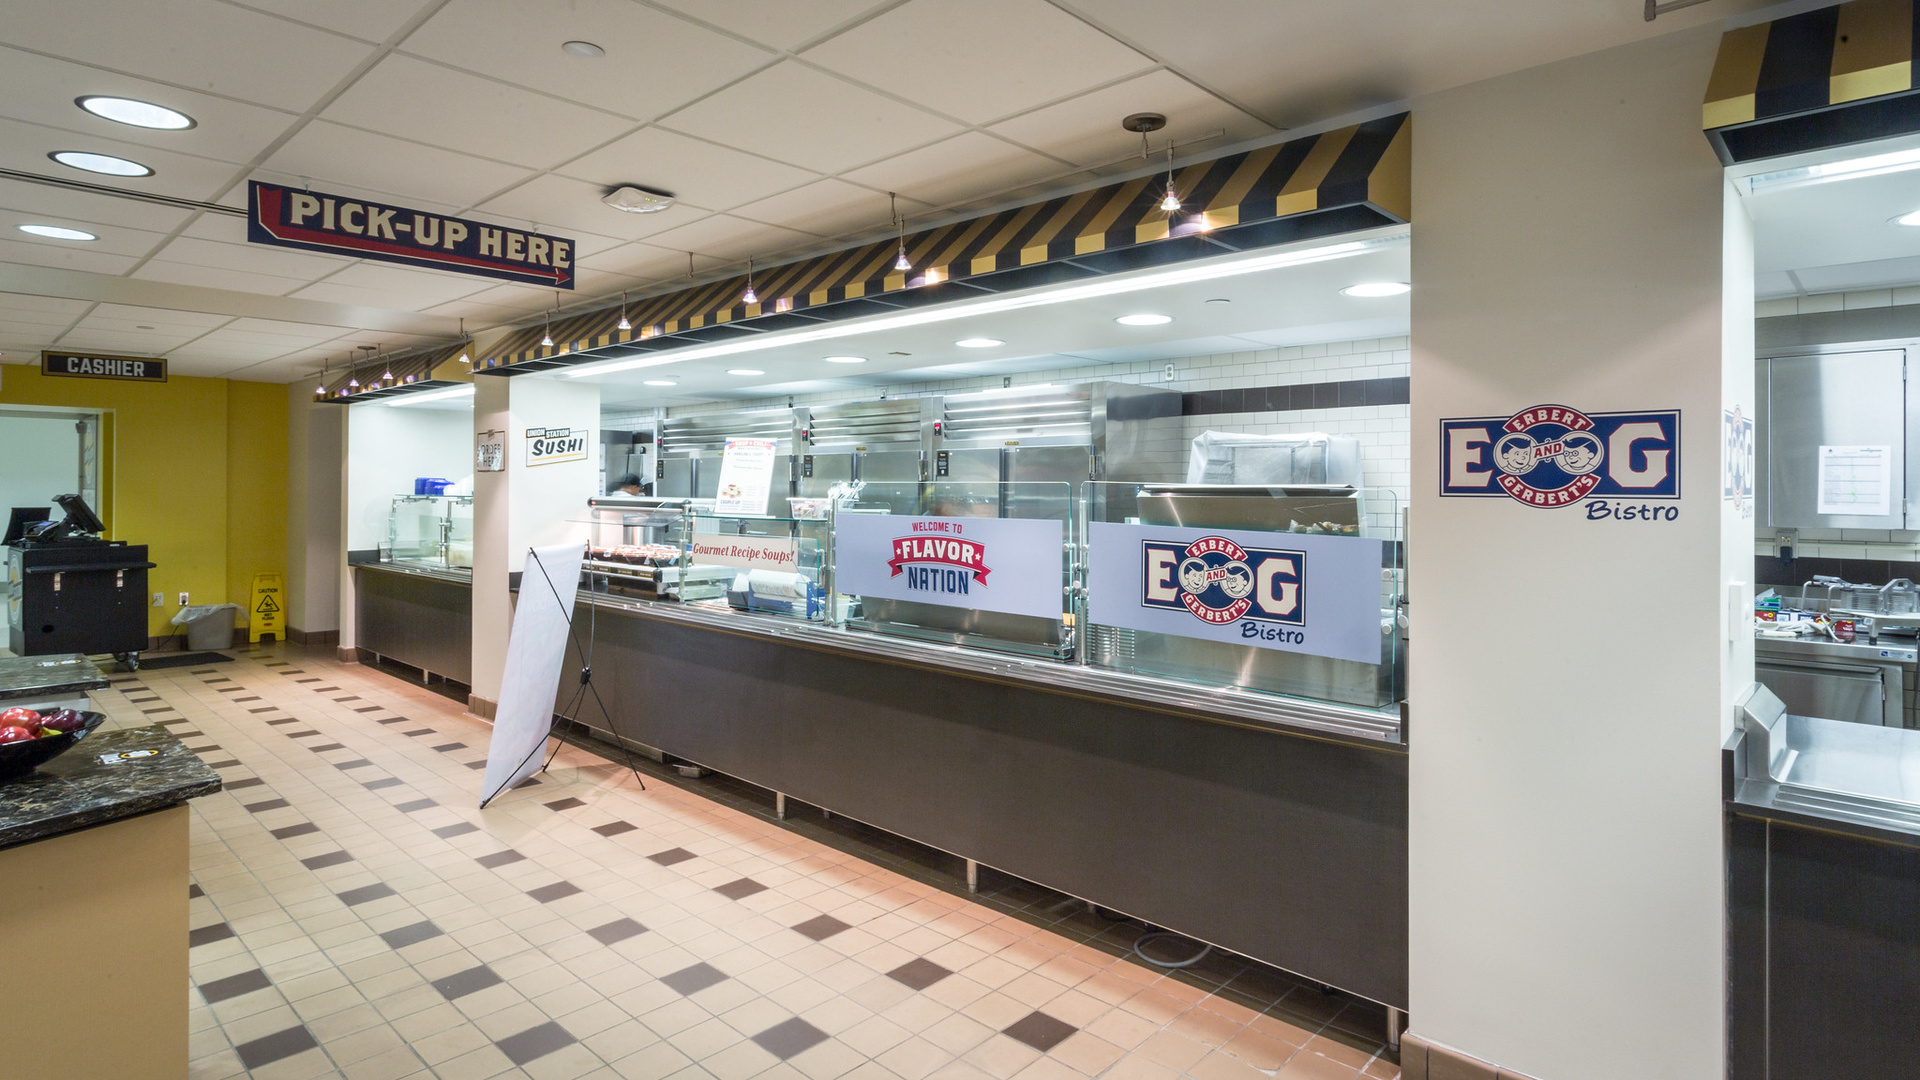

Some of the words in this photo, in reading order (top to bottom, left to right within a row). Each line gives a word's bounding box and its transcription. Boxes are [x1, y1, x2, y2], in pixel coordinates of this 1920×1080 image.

[289, 192, 468, 250] PICK-UP
[478, 226, 571, 269] HERE
[67, 356, 145, 377] CASHIER
[1512, 408, 1588, 432] ERBERT
[527, 428, 546, 438] UNION
[545, 428, 570, 439] STATION
[532, 438, 584, 457] SUSHI
[1447, 427, 1494, 488] E
[1607, 421, 1672, 488] G
[1532, 442, 1563, 459] AND
[1503, 474, 1594, 506] GERBERT'S
[1584, 500, 1679, 522] Bistro
[912, 522, 950, 532] WELCOME
[952, 523, 963, 534] TO
[693, 542, 729, 557] Gourmet
[730, 545, 761, 562] Recipe
[762, 547, 795, 565] Soups!
[901, 539, 975, 565] FLAVOR
[1191, 538, 1244, 561] ERBERT
[908, 566, 969, 595] NATION
[1146, 548, 1179, 602] E
[1256, 557, 1299, 616] G
[1205, 569, 1226, 582] AND
[1185, 594, 1248, 623] GERBERT'S
[1240, 621, 1304, 645] Bistro
